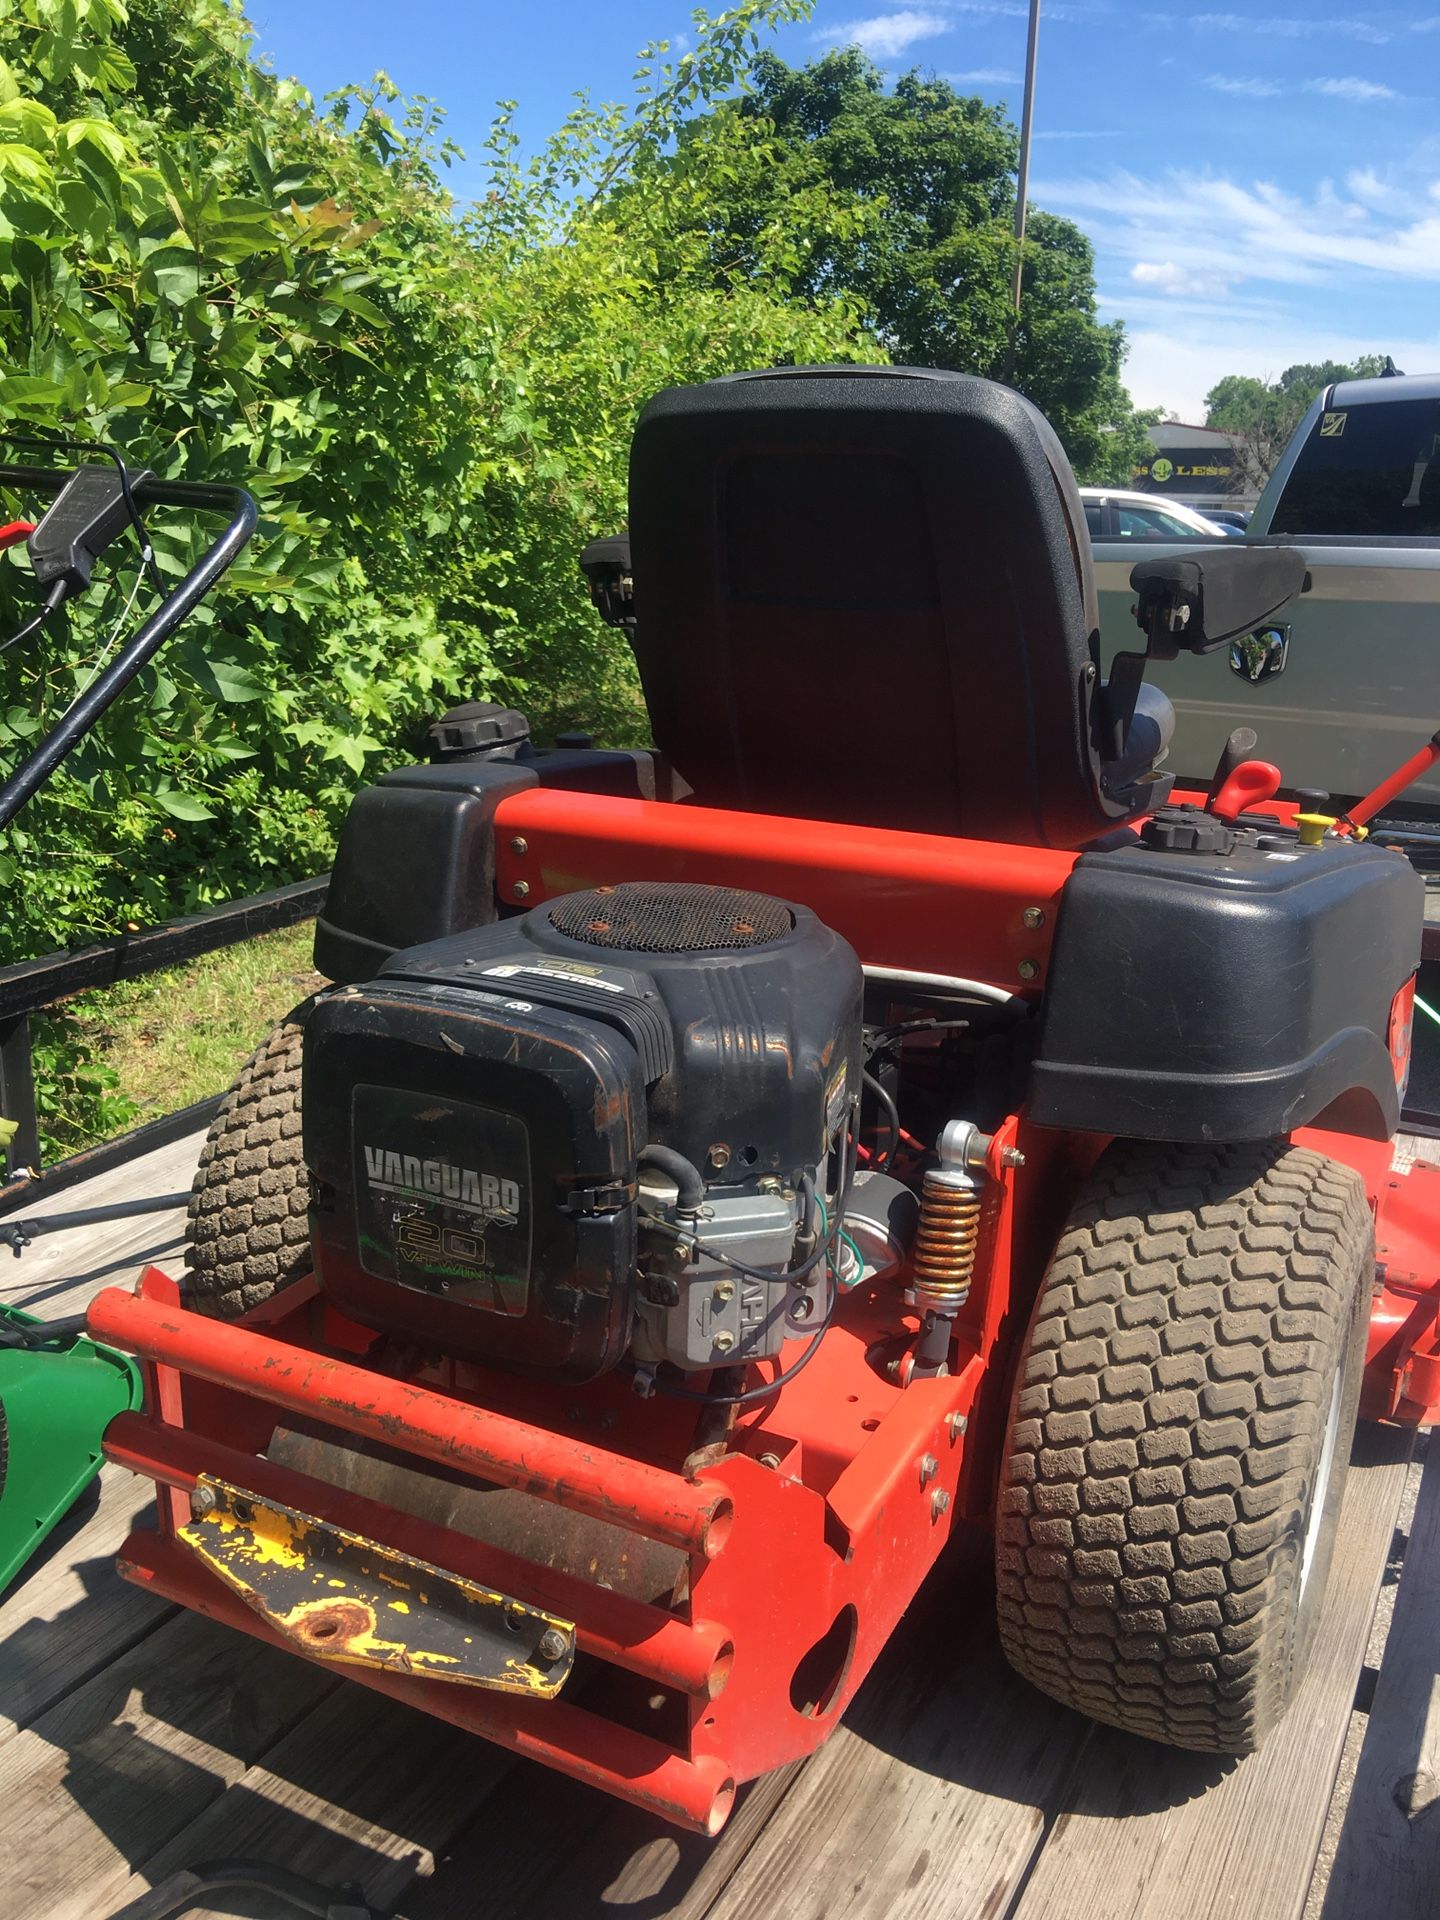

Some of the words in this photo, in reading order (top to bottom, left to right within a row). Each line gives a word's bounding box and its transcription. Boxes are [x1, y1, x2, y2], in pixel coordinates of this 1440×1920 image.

[1176, 465, 1231, 476] LESS
[364, 1145, 519, 1215] VANGUARD
[439, 1198, 465, 1210] POWER
[398, 1216, 486, 1265] 20
[400, 1247, 486, 1283] V-TWIN
